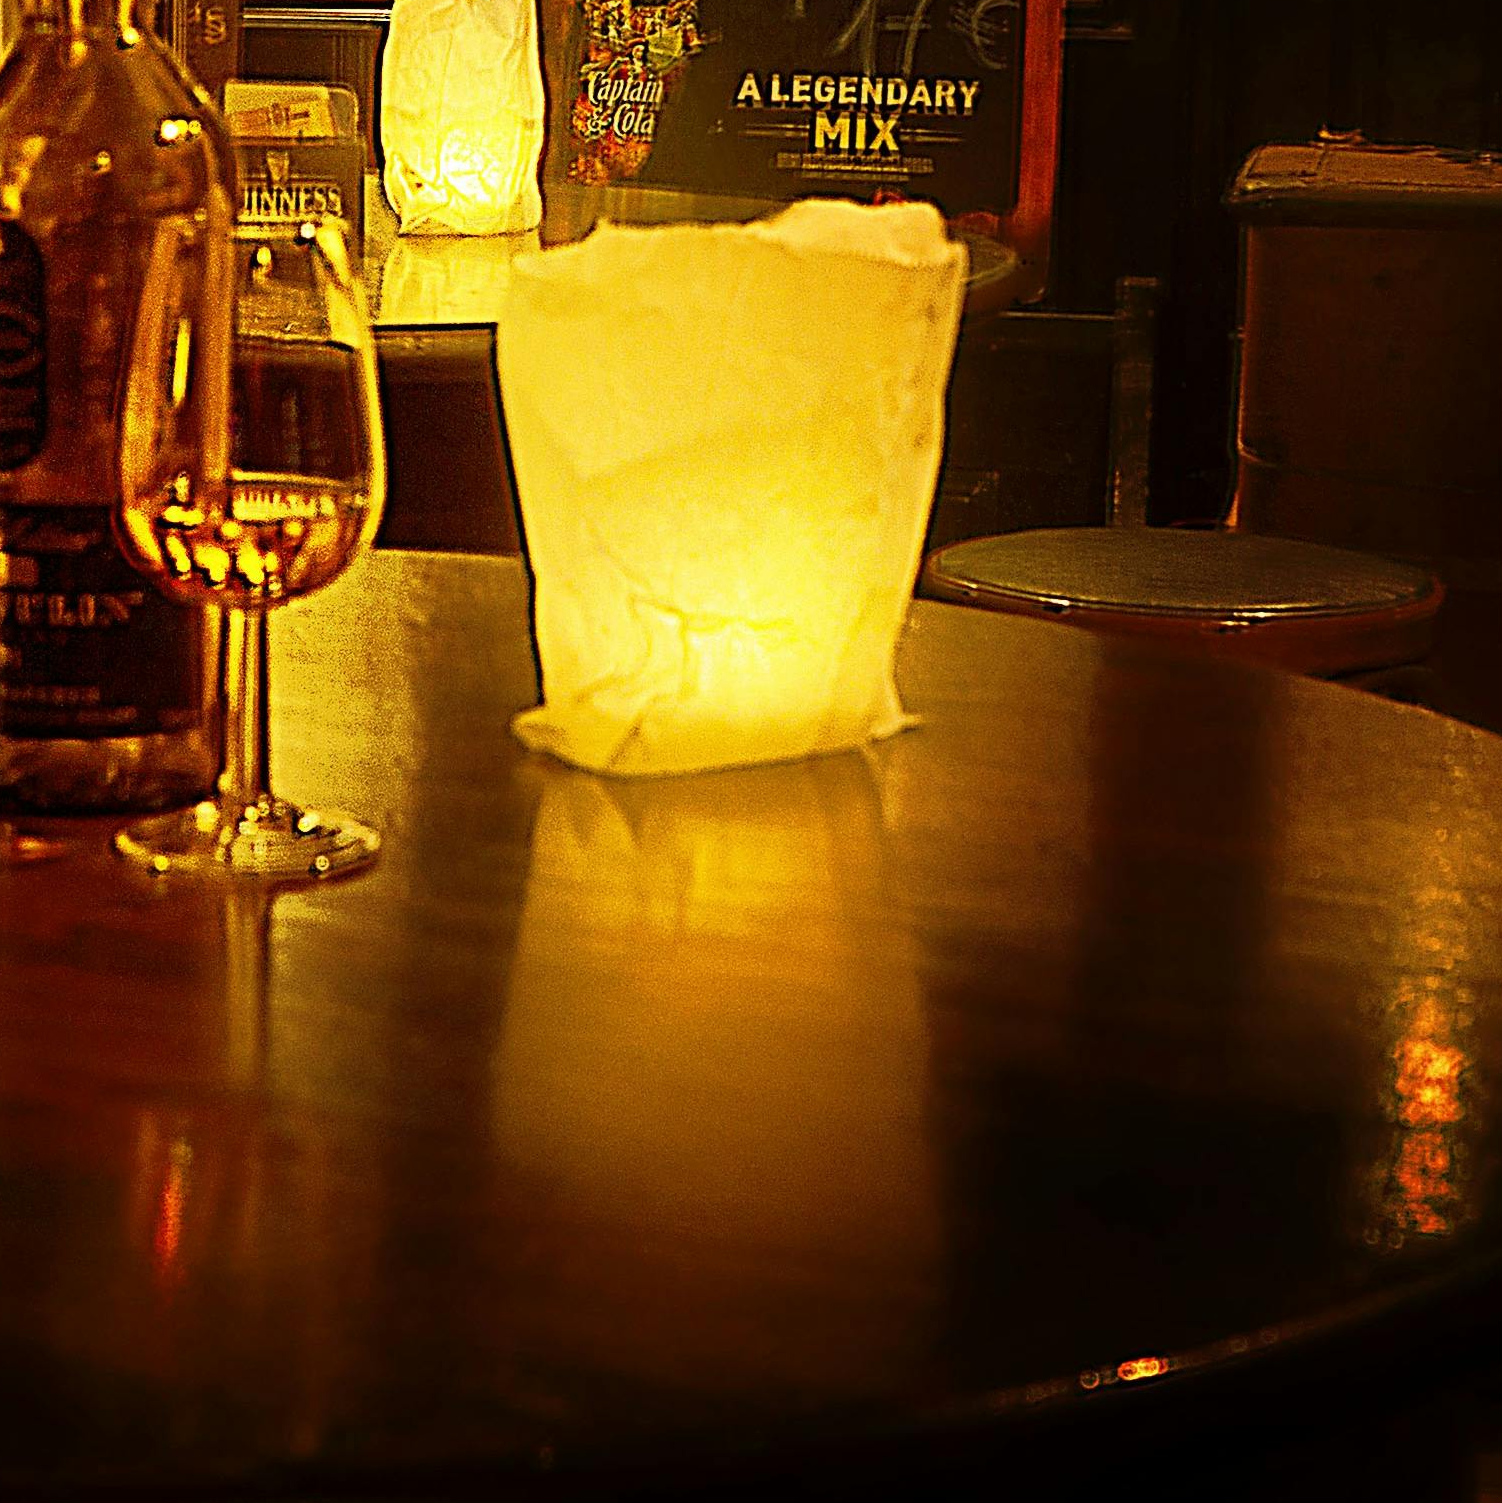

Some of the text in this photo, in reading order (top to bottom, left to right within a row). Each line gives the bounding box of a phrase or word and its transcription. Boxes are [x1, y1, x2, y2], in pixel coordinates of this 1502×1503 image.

[587, 70, 665, 110] Captain
[737, 72, 982, 113] A LEGENDARY
[613, 103, 658, 141] Cola
[814, 111, 901, 155] MIX
